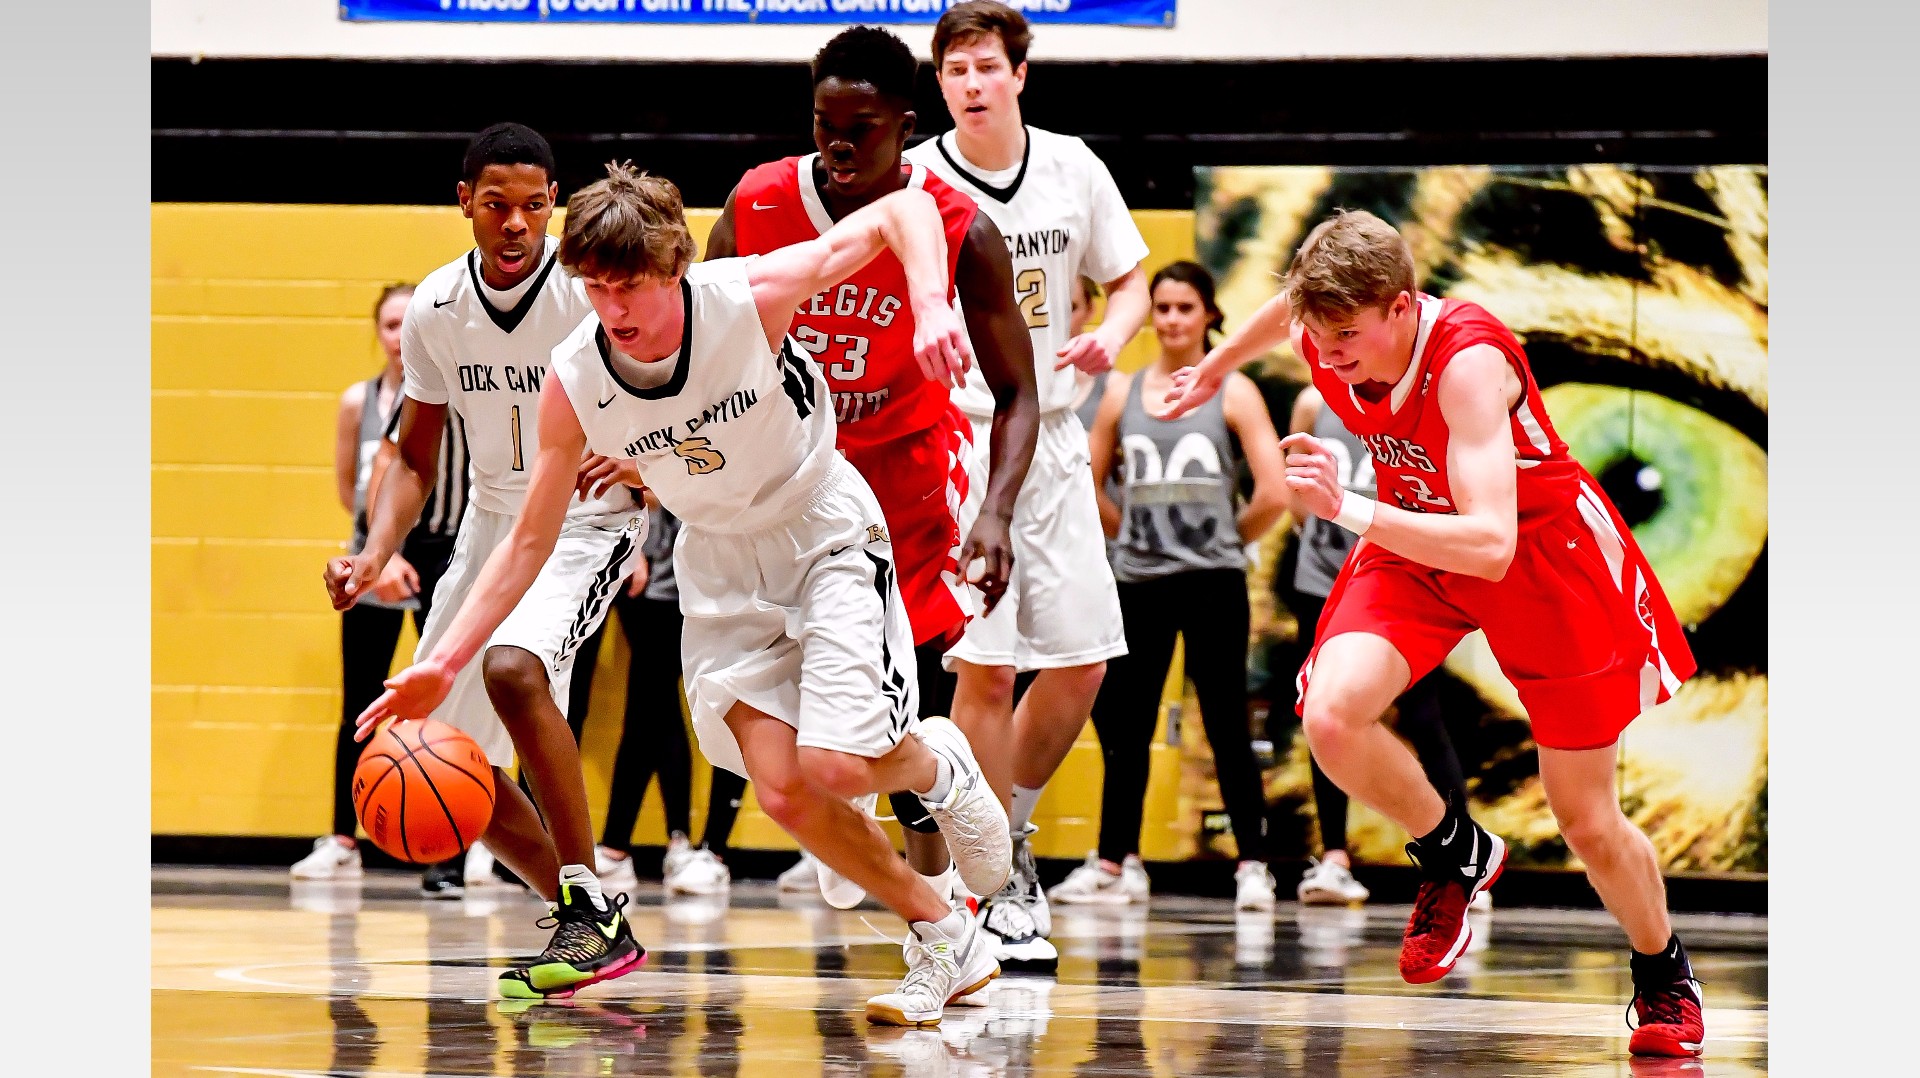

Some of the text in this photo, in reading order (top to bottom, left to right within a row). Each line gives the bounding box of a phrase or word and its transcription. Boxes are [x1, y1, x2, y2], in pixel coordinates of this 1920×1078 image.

[795, 283, 902, 327] EGIS
[795, 325, 869, 381] 23
[456, 363, 500, 392] OCK
[511, 404, 525, 472] 1
[673, 436, 726, 476] 5
